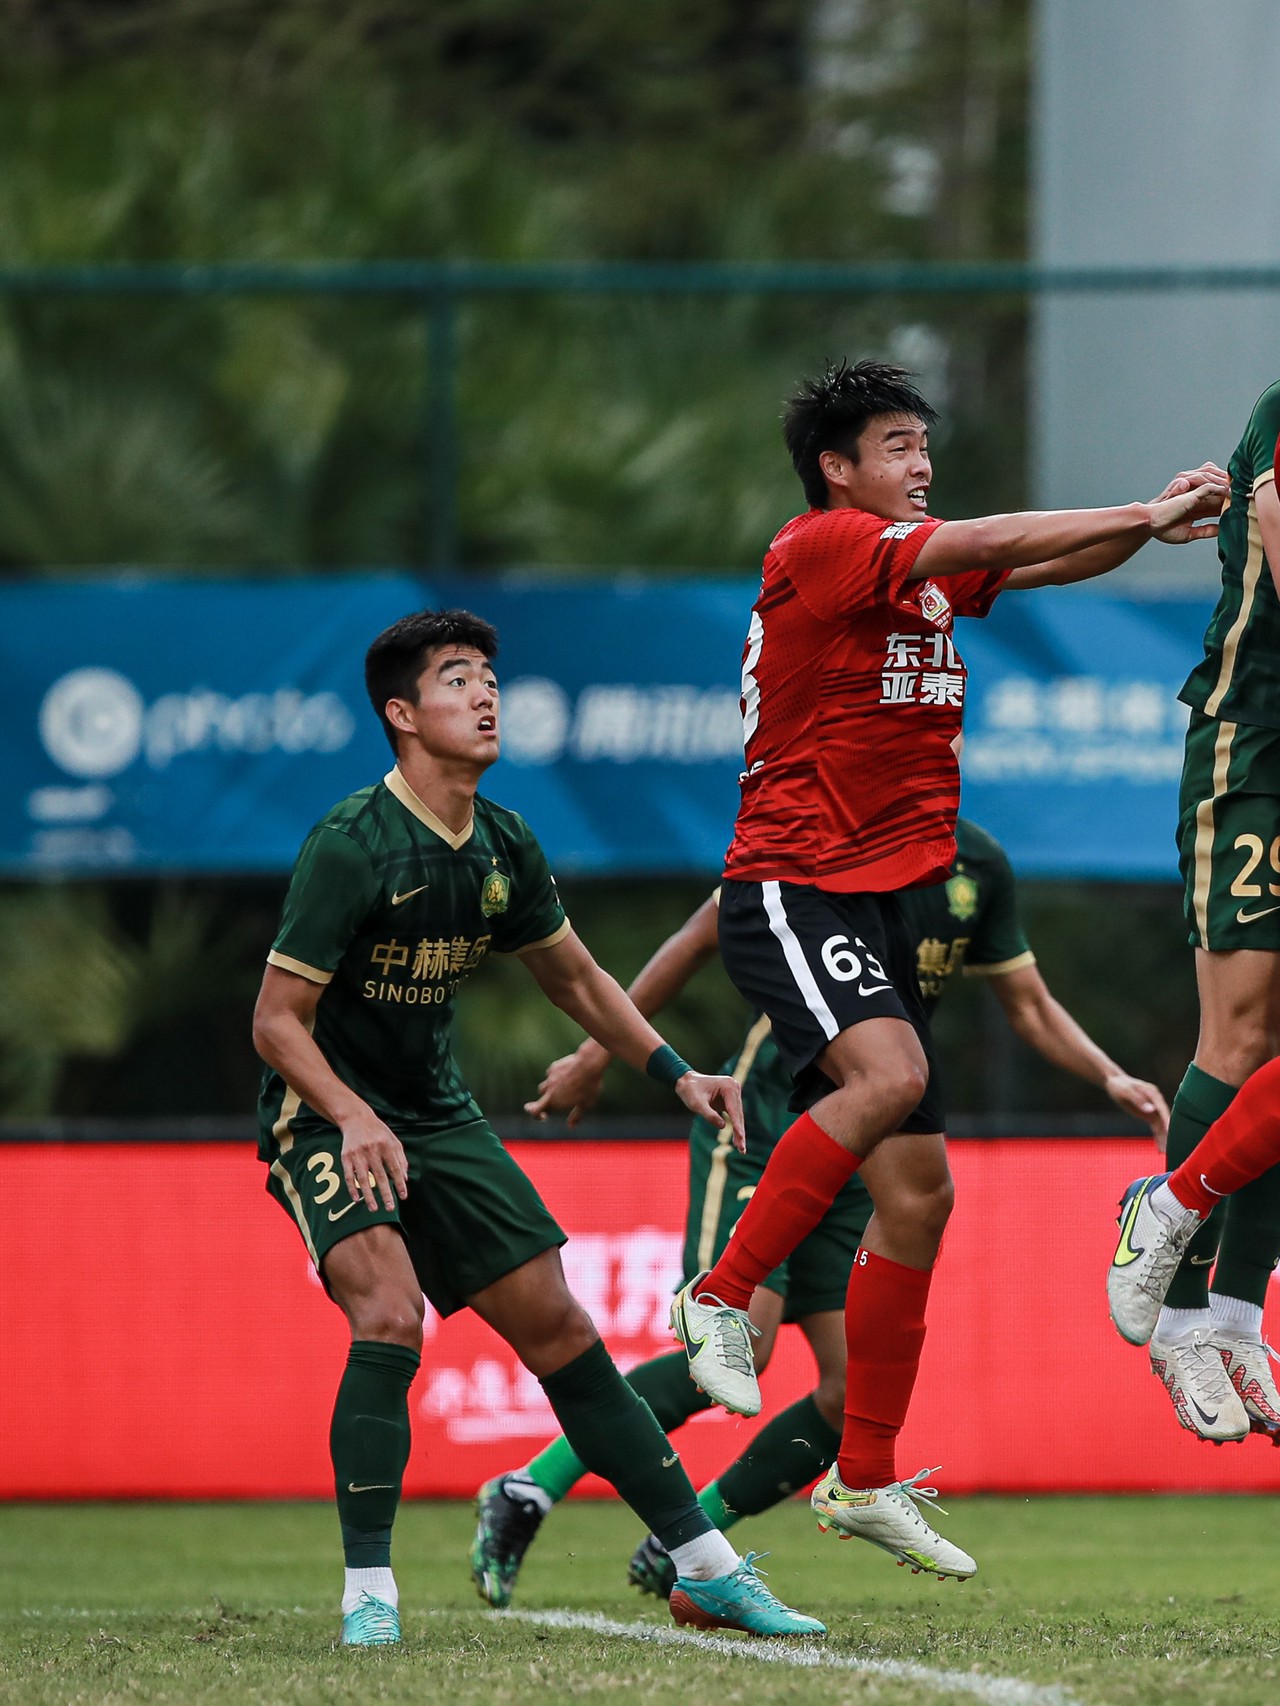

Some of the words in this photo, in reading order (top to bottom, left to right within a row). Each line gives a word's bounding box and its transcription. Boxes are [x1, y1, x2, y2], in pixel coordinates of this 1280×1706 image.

[879, 672, 964, 708] 亚泰
[370, 934, 492, 981] 中赫集团
[362, 980, 446, 1005] SINOBO
